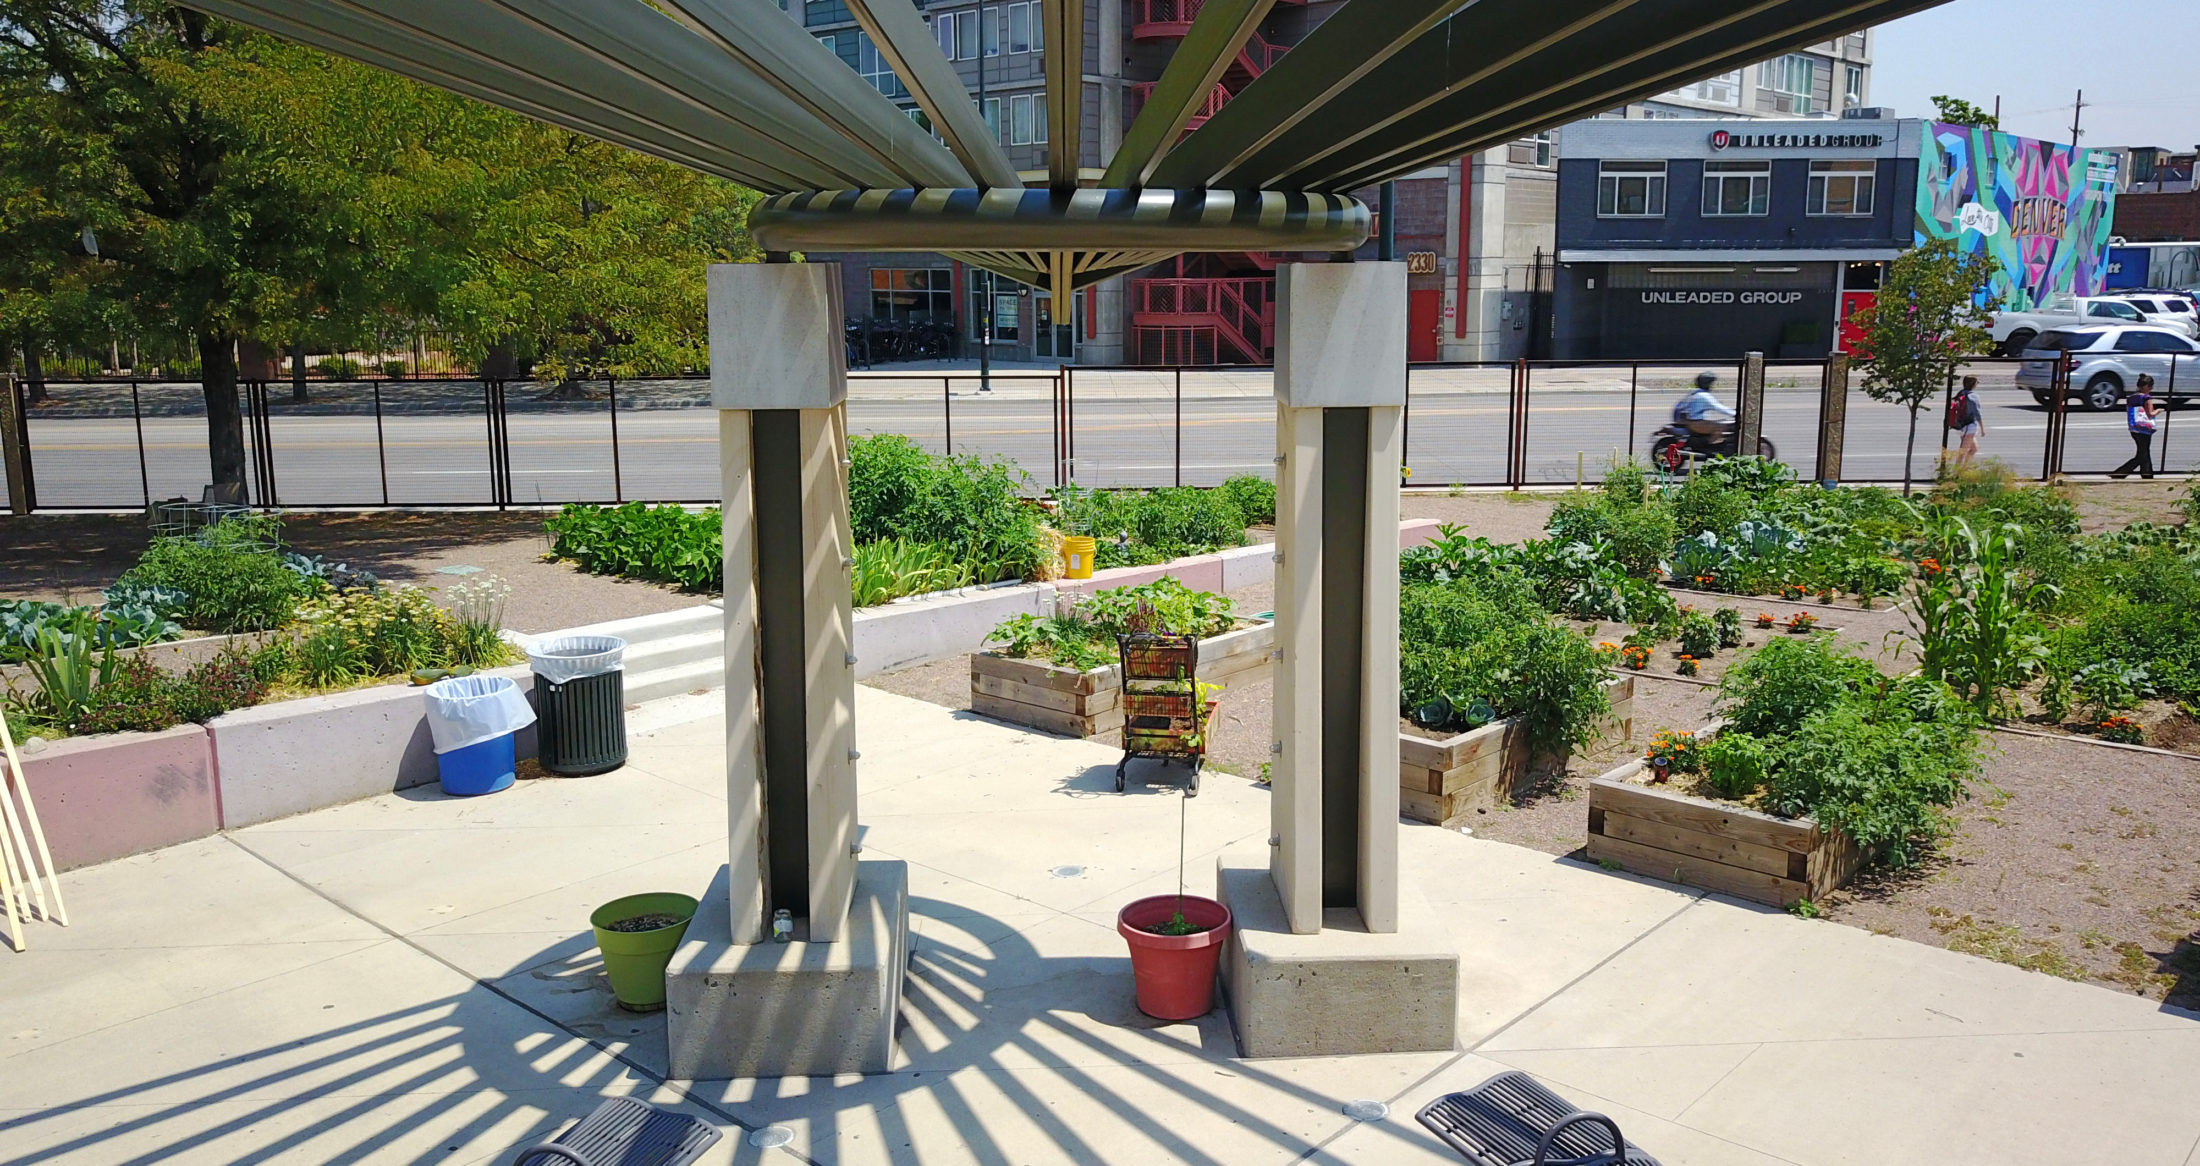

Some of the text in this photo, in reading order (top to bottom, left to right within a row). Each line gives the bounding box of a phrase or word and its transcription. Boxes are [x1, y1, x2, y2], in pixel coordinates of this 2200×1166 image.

[2010, 197, 2067, 239] DENVER
[1408, 252, 1436, 272] 2330
[1641, 291, 1802, 304] UNLEADED GROUP
